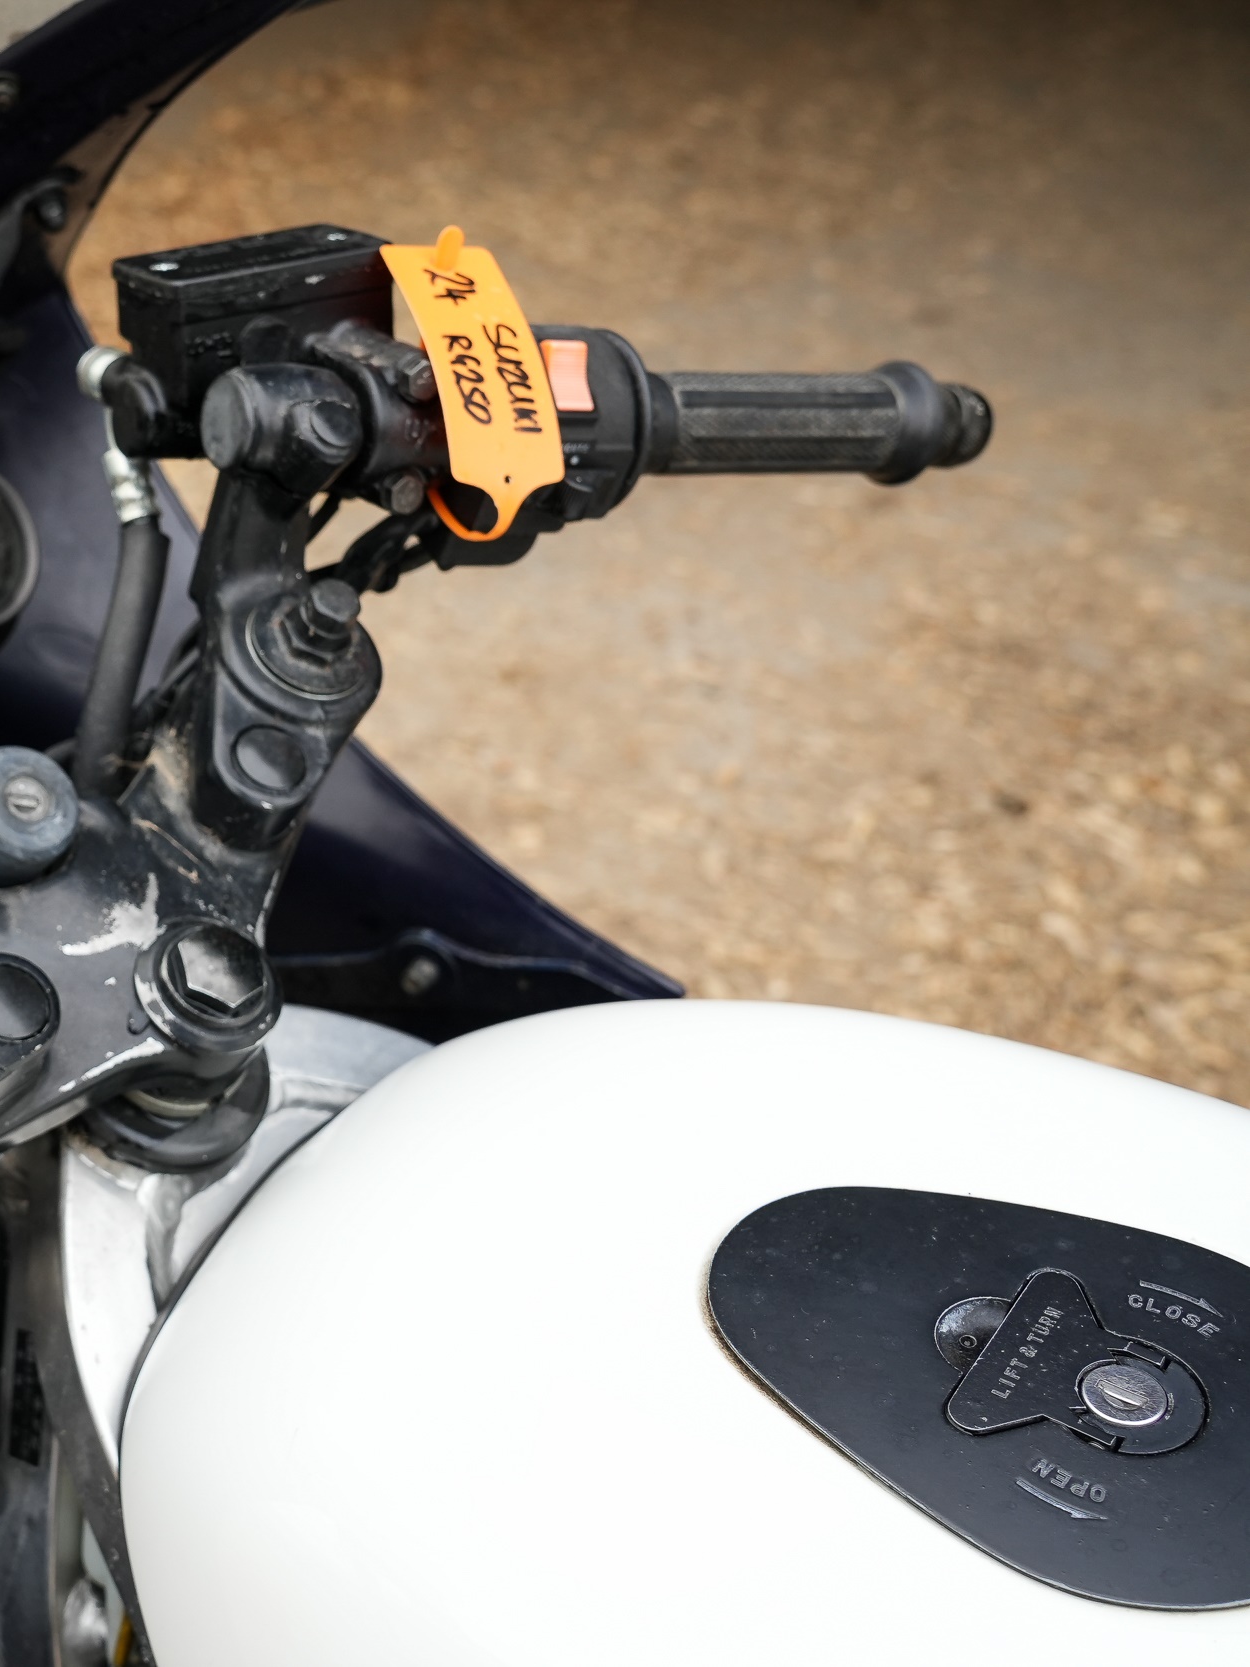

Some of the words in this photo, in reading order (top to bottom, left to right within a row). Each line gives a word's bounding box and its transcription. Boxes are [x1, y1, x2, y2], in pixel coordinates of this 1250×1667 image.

[423, 268, 476, 305] 24
[442, 334, 492, 425] RG250
[482, 323, 543, 433] SUZUKI
[1026, 1306, 1065, 1344] TURN
[1127, 1293, 1221, 1339] CLOSE
[1018, 1343, 1038, 1358] &
[990, 1358, 1028, 1400] LIFT
[1030, 1458, 1108, 1503] OPEN
